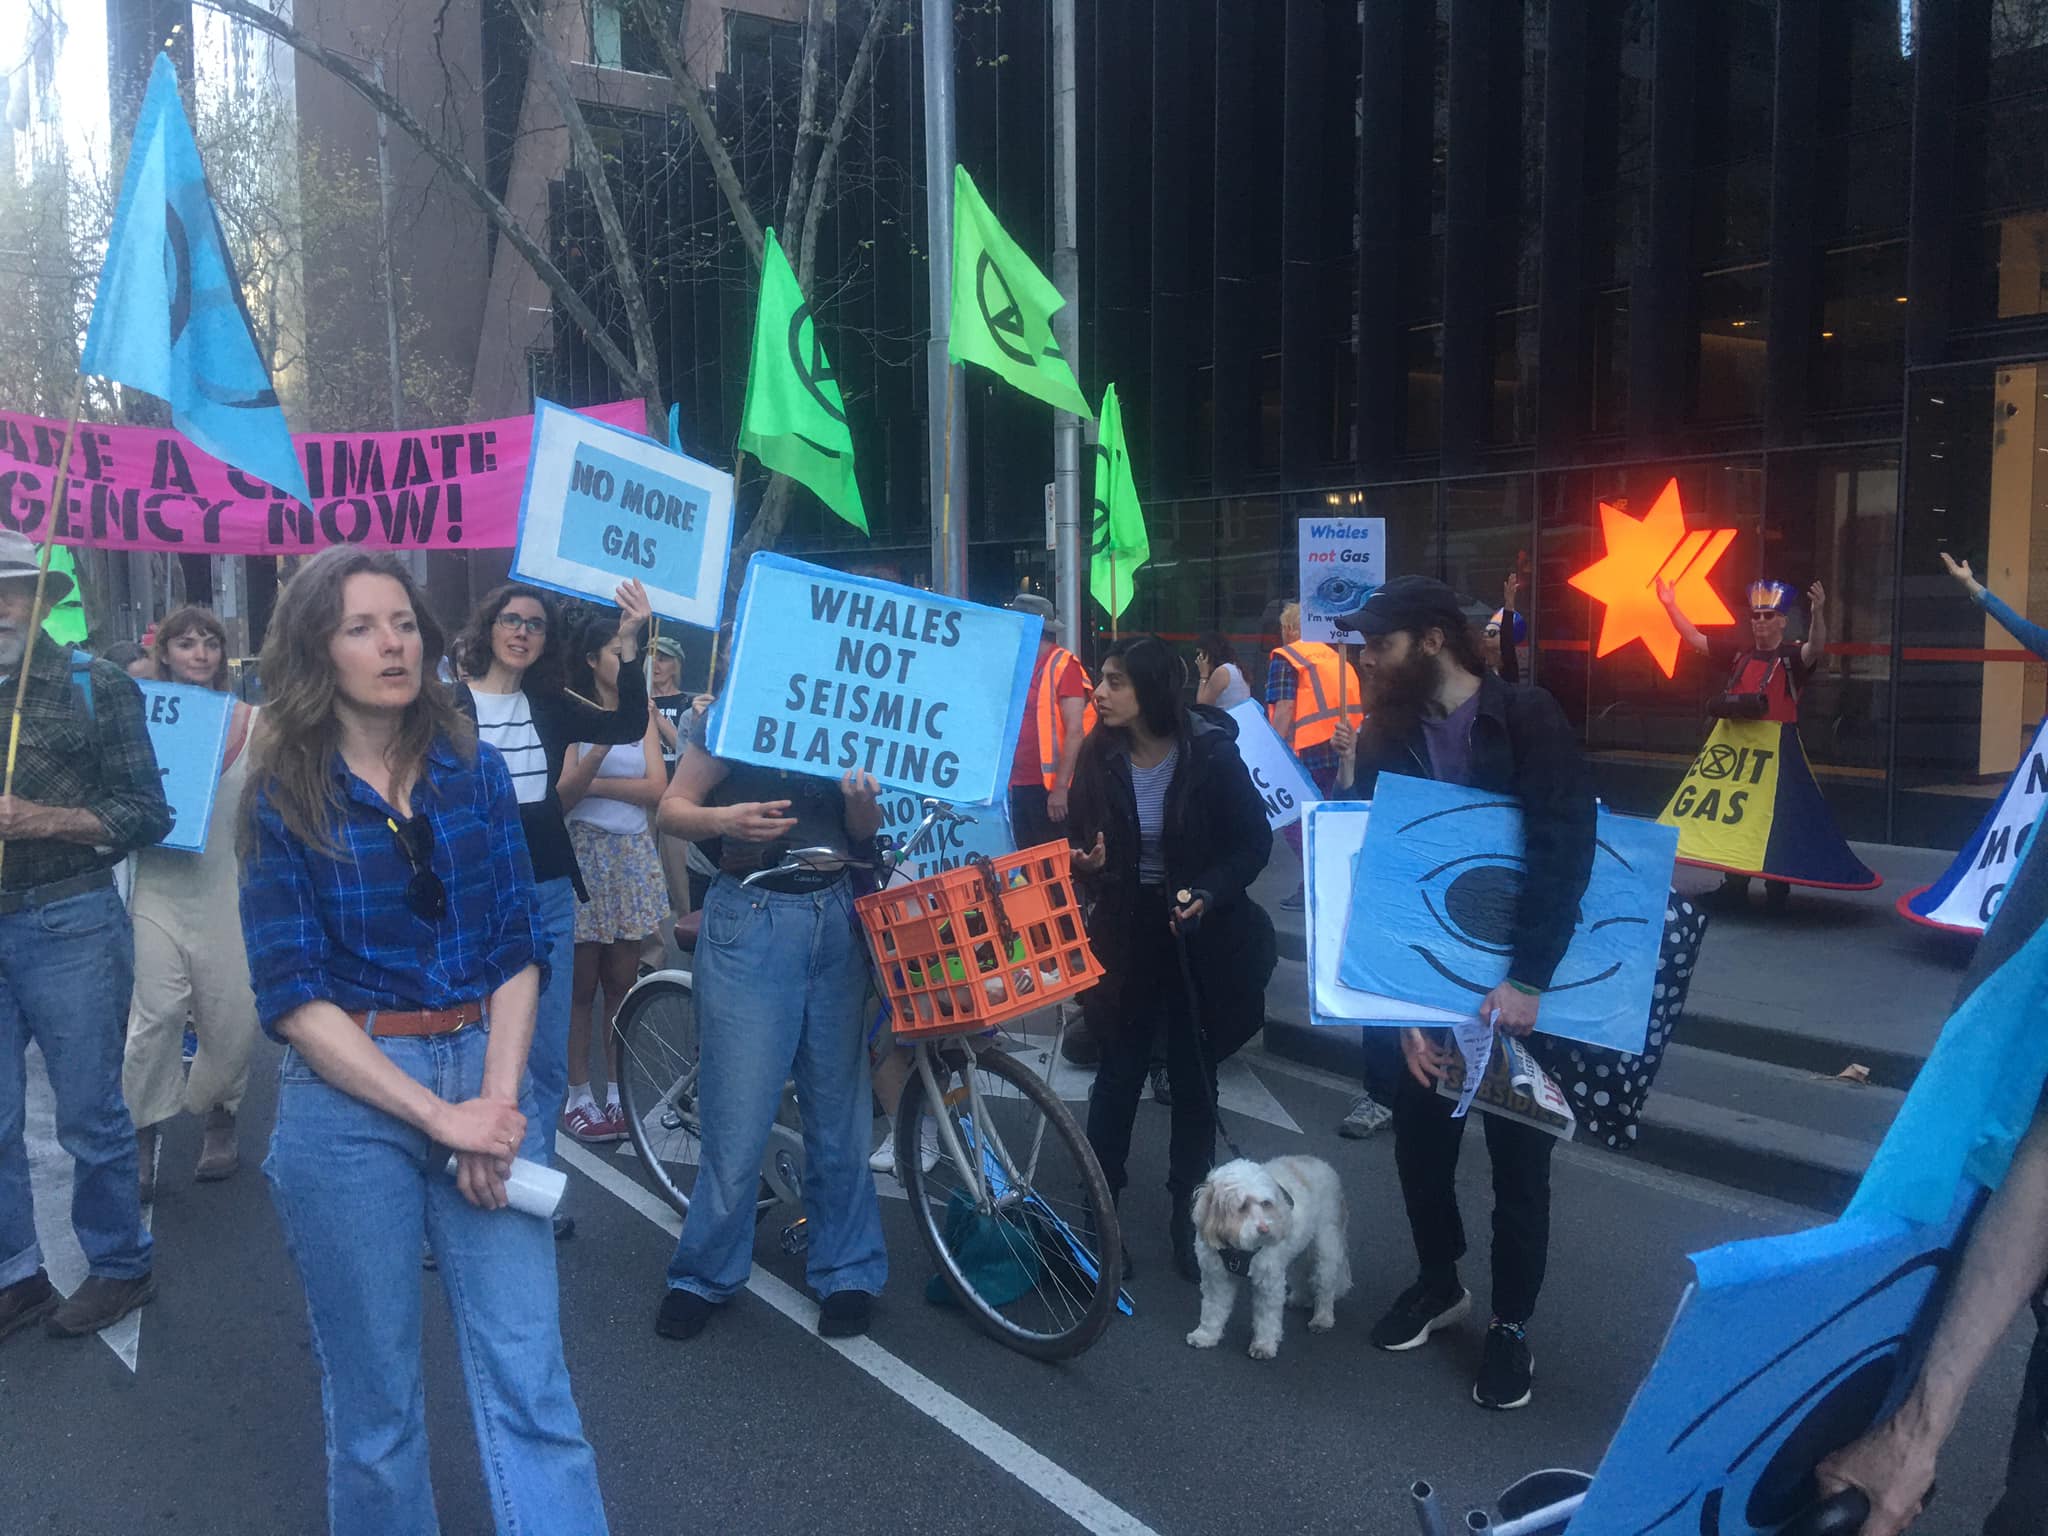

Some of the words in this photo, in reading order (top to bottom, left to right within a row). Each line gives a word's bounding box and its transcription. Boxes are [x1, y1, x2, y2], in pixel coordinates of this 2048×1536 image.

[151, 439, 199, 494] A
[226, 431, 498, 500] IMATE
[0, 470, 234, 544] GENCY
[267, 483, 462, 545] NOW!
[571, 460, 615, 503] NO
[620, 479, 698, 532] MORE
[602, 524, 657, 569] GAS
[1308, 549, 1336, 562] not
[1340, 549, 1370, 563] Gas
[1310, 525, 1369, 539] Whales
[810, 584, 962, 648] WHALES
[1330, 630, 1349, 639] you
[835, 636, 917, 684] NOT
[785, 673, 949, 740] SEISMIC
[752, 715, 960, 789] BLASTING
[1672, 784, 1749, 825] GAS
